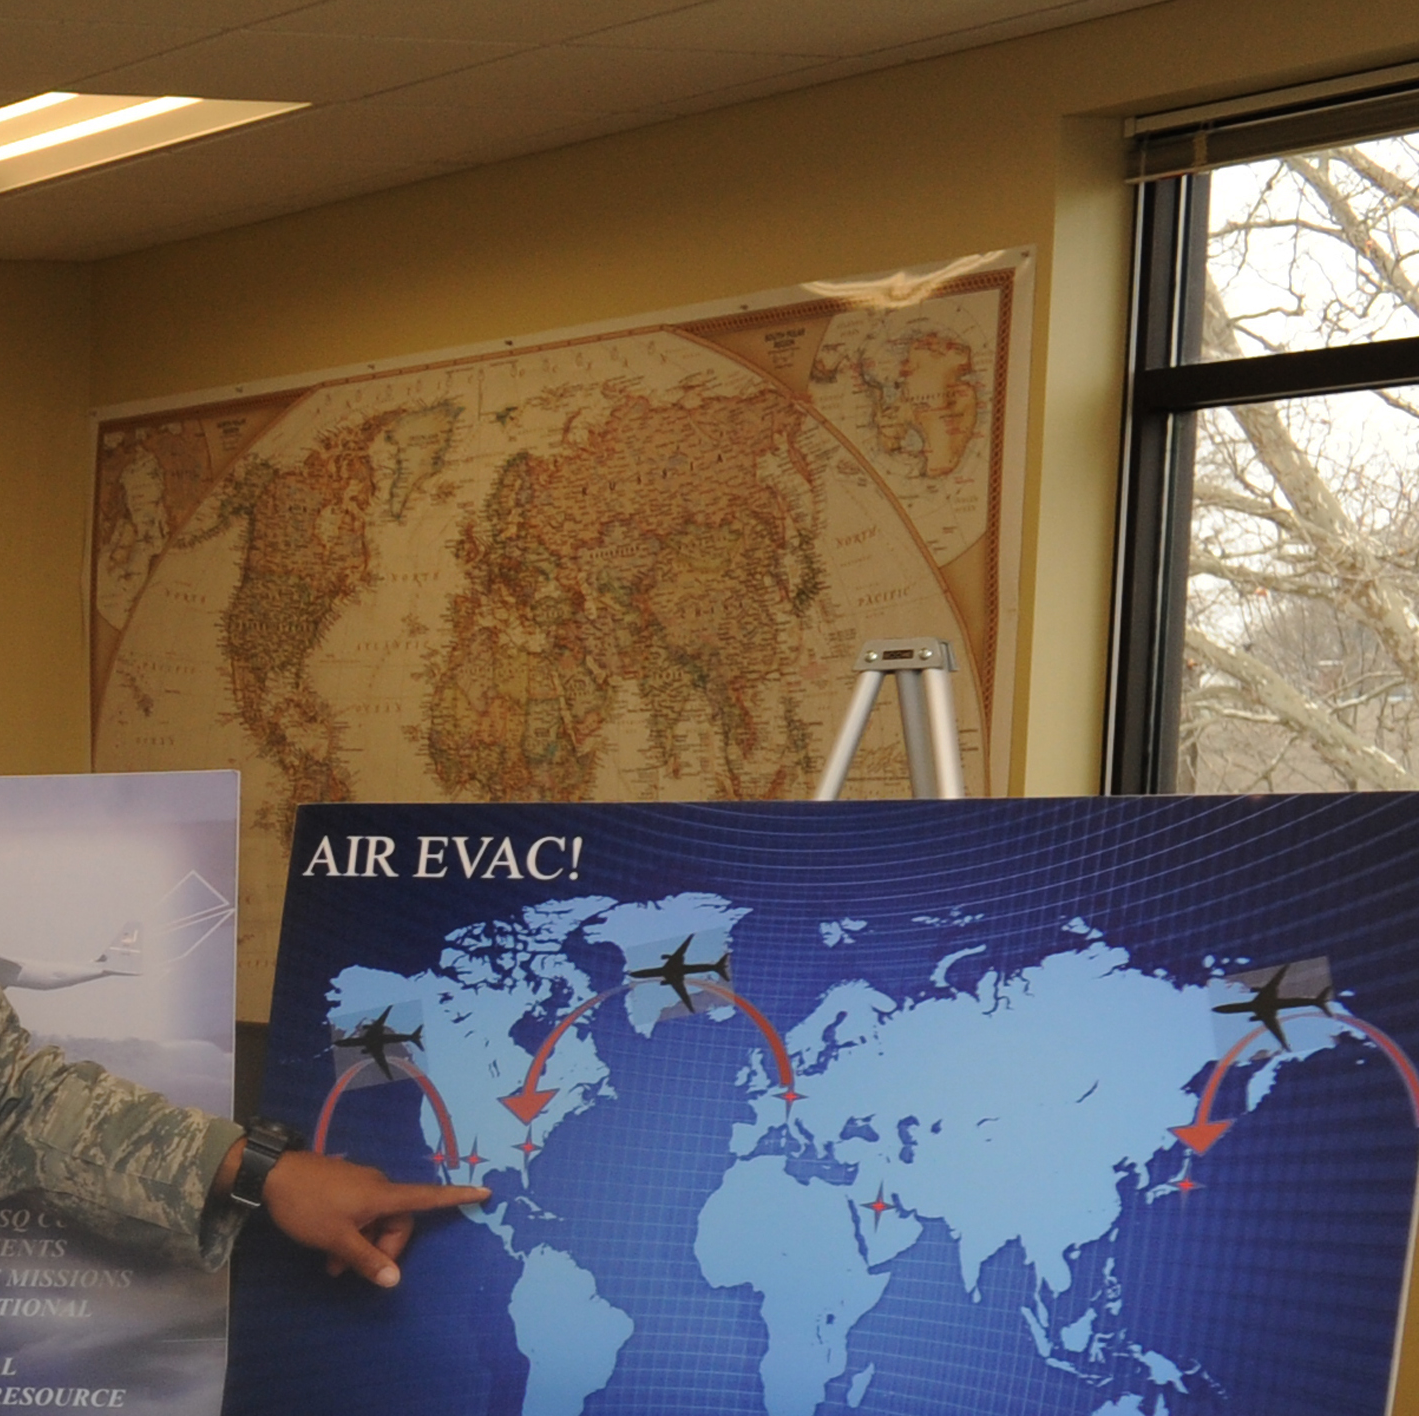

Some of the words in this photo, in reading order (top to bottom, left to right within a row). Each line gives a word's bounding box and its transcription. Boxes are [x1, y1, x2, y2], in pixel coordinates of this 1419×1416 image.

[302, 835, 399, 878] AIR
[412, 836, 583, 880] EVAC!
[5, 1269, 134, 1290] MISSIONS
